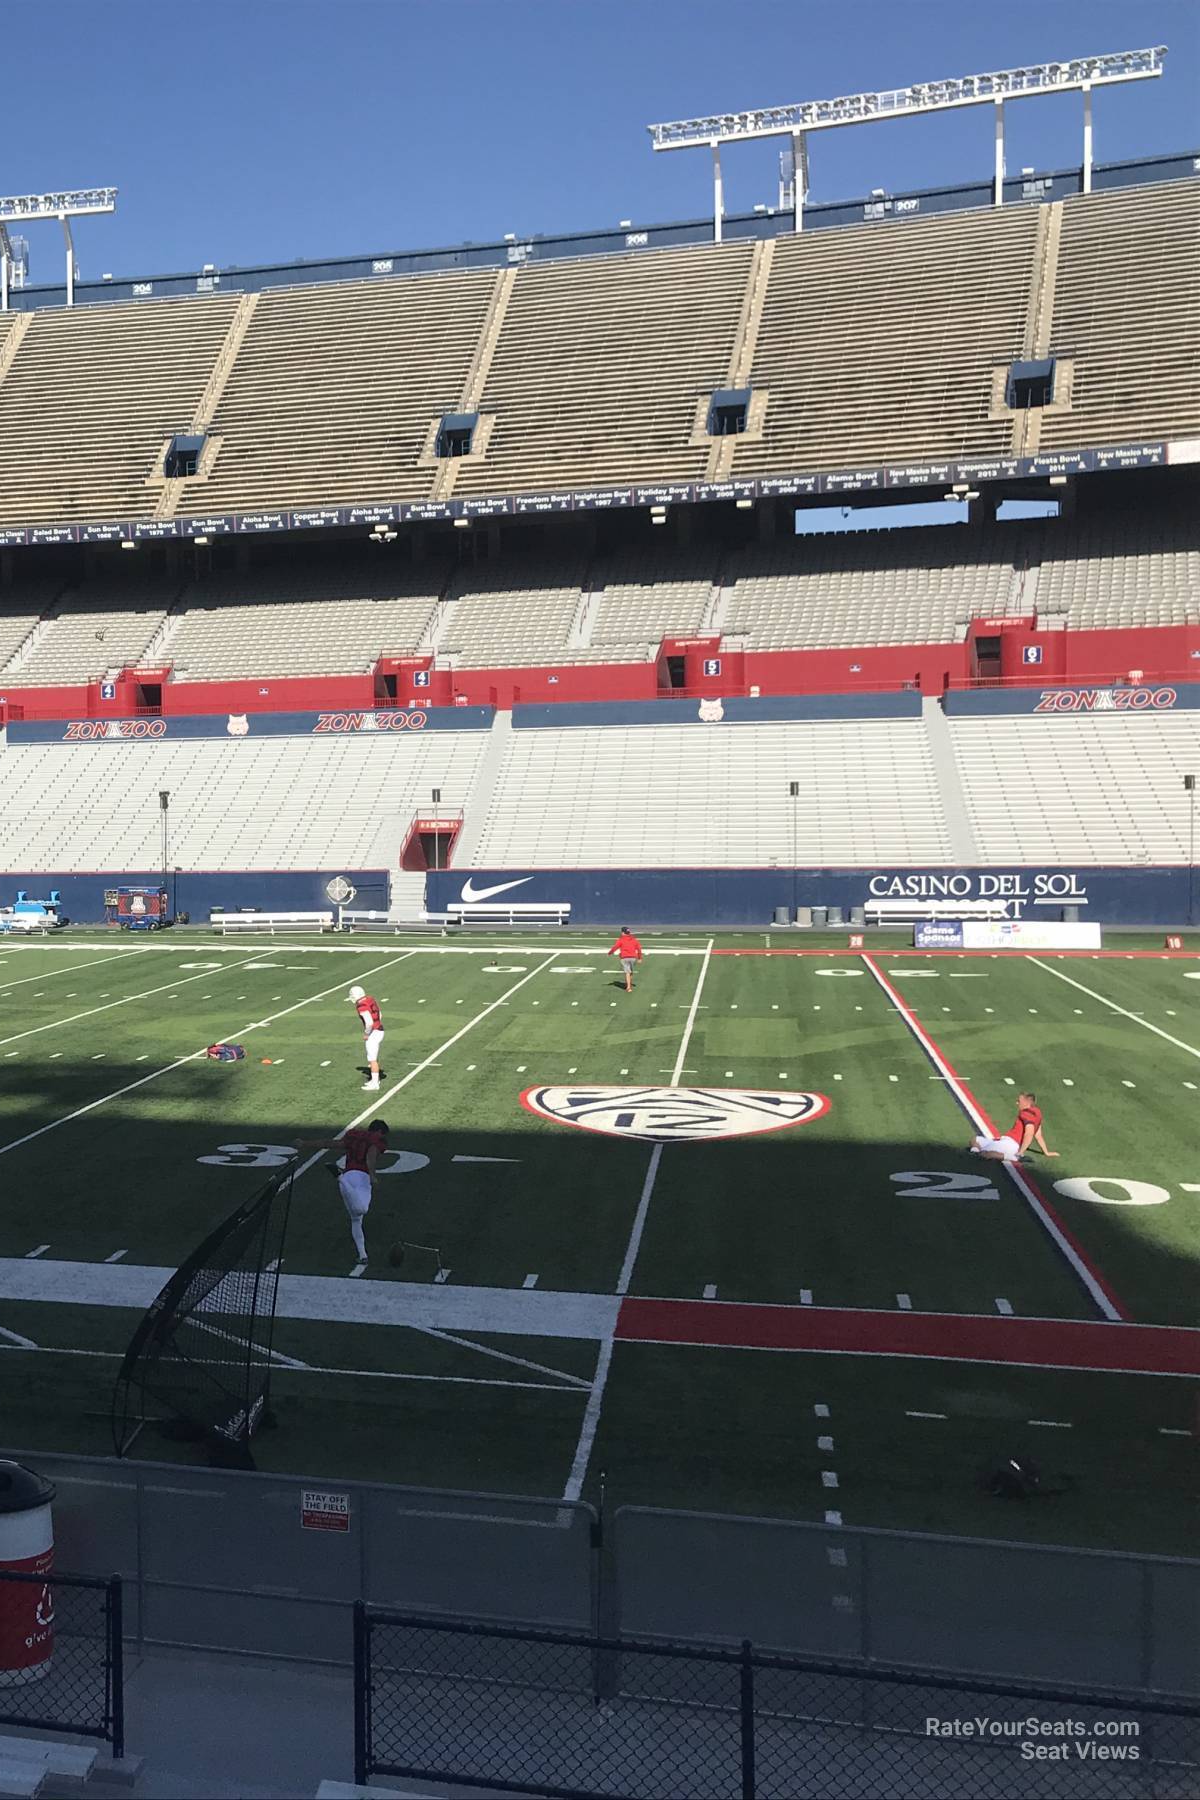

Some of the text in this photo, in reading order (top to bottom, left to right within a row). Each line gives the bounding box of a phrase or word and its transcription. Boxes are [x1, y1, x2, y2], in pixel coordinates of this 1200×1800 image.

[1034, 454, 1080, 466] Fiesta Bowl
[827, 472, 878, 483] Alamo Bowl
[638, 486, 689, 497] Holiday Bowl
[426, 503, 445, 511] Bowl
[487, 499, 506, 507] Bowl
[374, 507, 392, 515] Bowl
[263, 514, 281, 522] Bowl
[869, 873, 1087, 896] CASINO DEL SOL
[923, 926, 955, 935] Game
[918, 933, 961, 944] Sponsor
[305, 1493, 345, 1505] STAY OFF
[304, 1501, 347, 1512] THE FIELD
